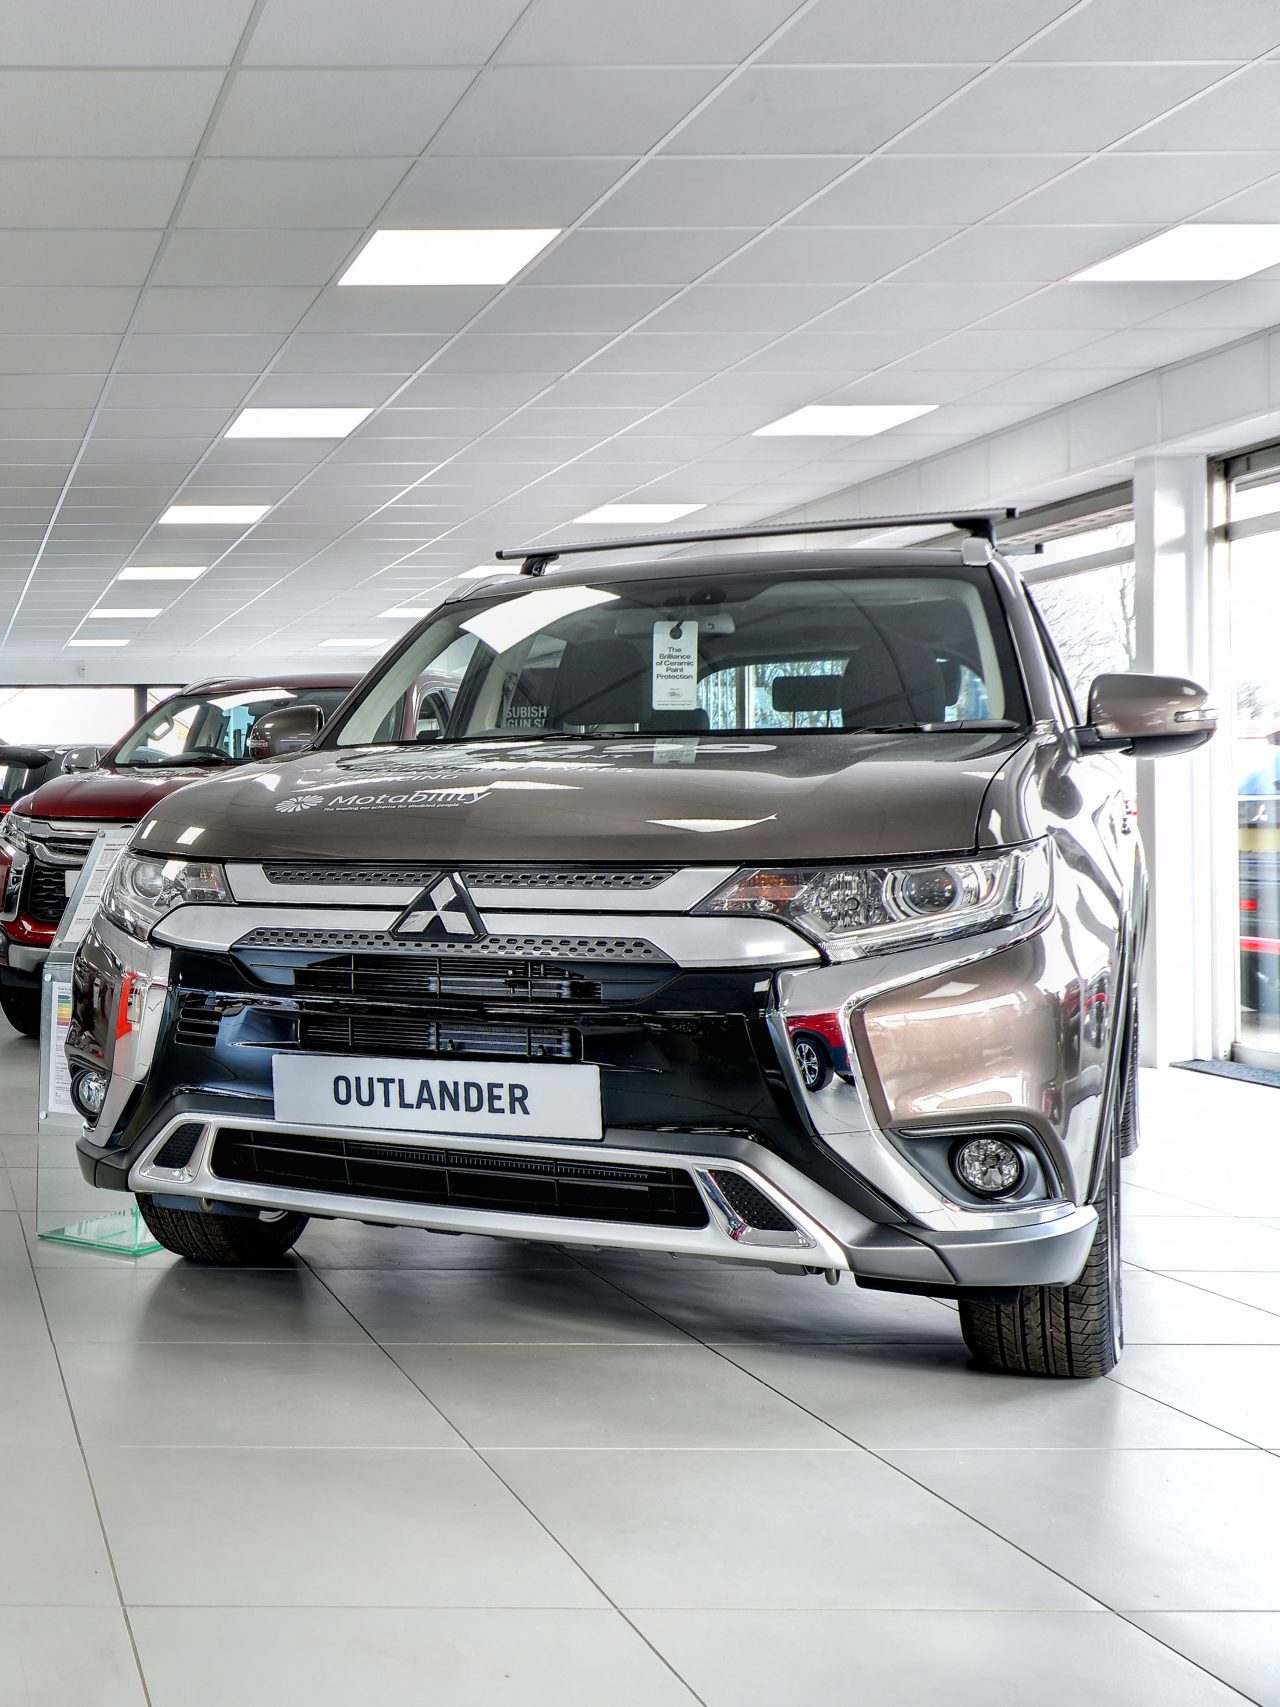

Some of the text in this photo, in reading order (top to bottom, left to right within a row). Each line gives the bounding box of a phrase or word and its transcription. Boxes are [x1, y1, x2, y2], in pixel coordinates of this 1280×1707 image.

[506, 705, 547, 718] SUBISH
[328, 791, 492, 806] Motability
[333, 1075, 530, 1115] OUTLANDER
